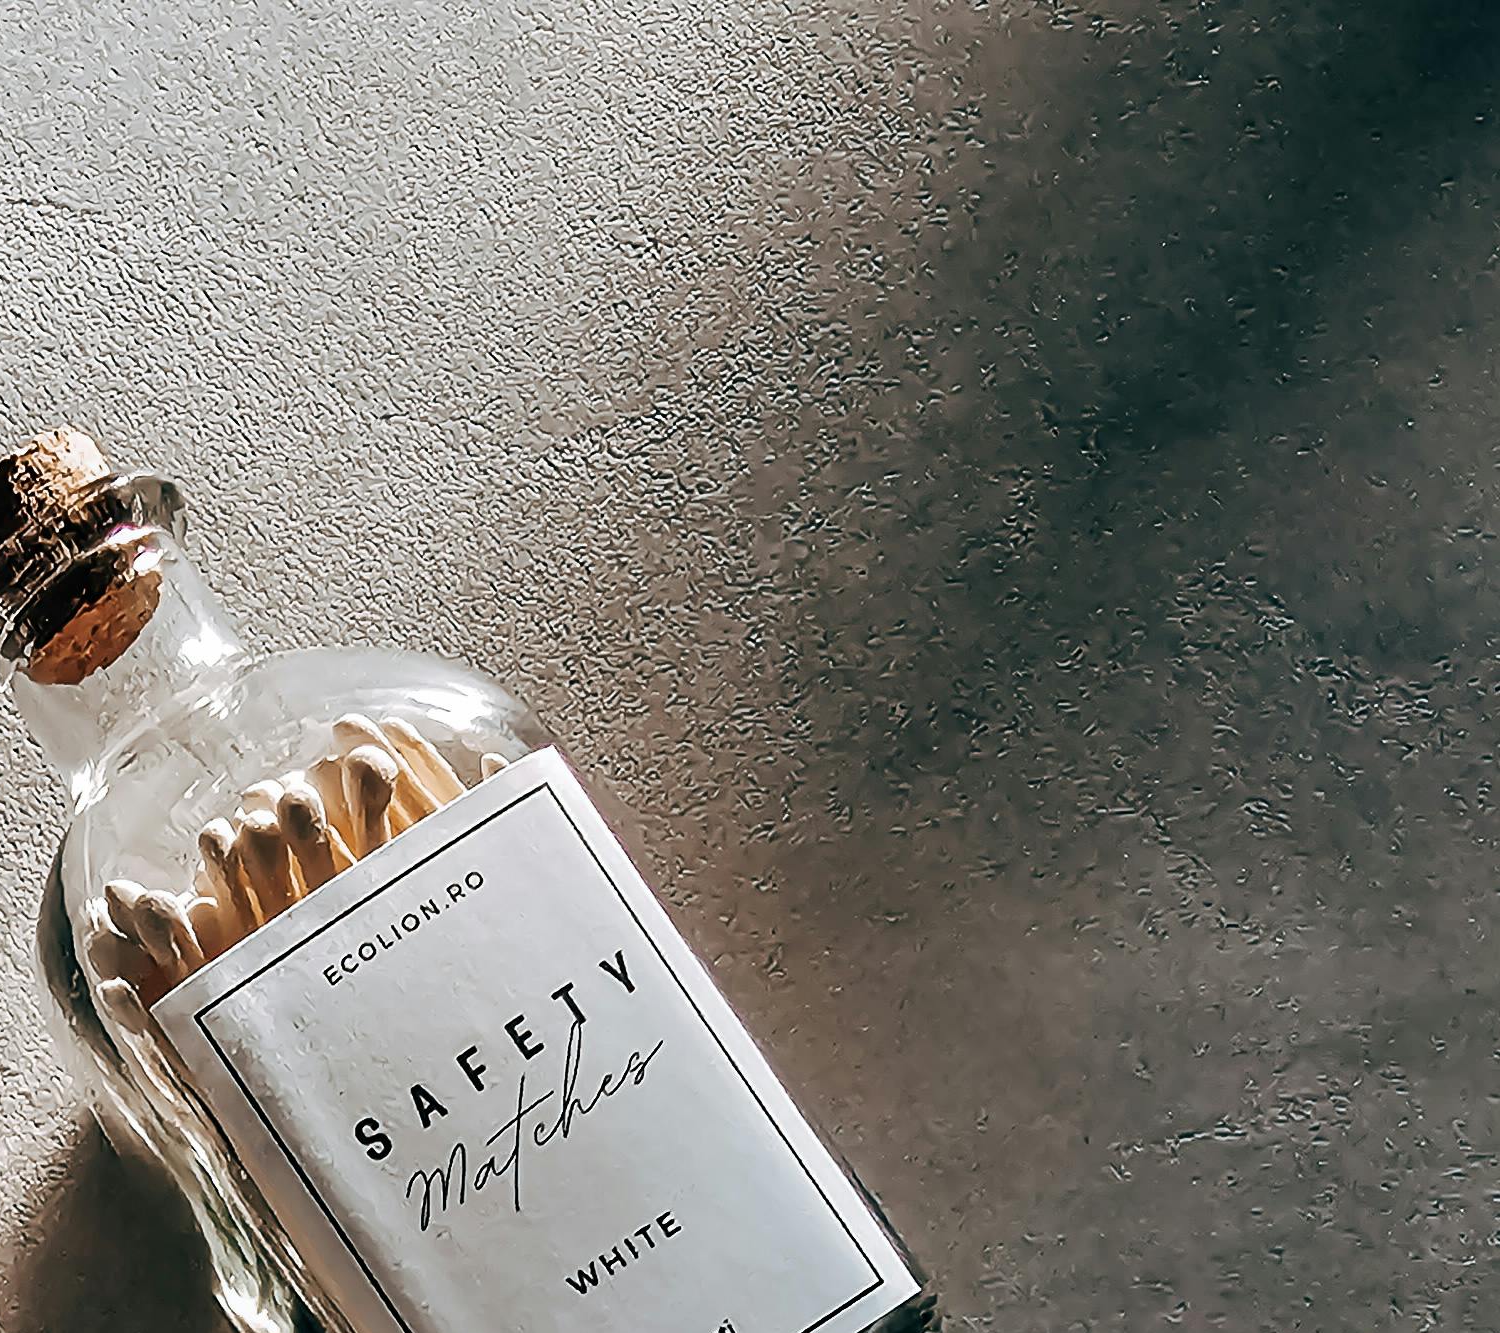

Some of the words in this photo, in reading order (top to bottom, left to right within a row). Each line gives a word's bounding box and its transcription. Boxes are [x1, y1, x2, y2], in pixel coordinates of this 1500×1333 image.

[323, 871, 485, 986] ECOLION.RO
[353, 950, 640, 1160] SAFETY
[406, 1021, 665, 1231] Matches
[566, 1209, 681, 1295] WHITE
